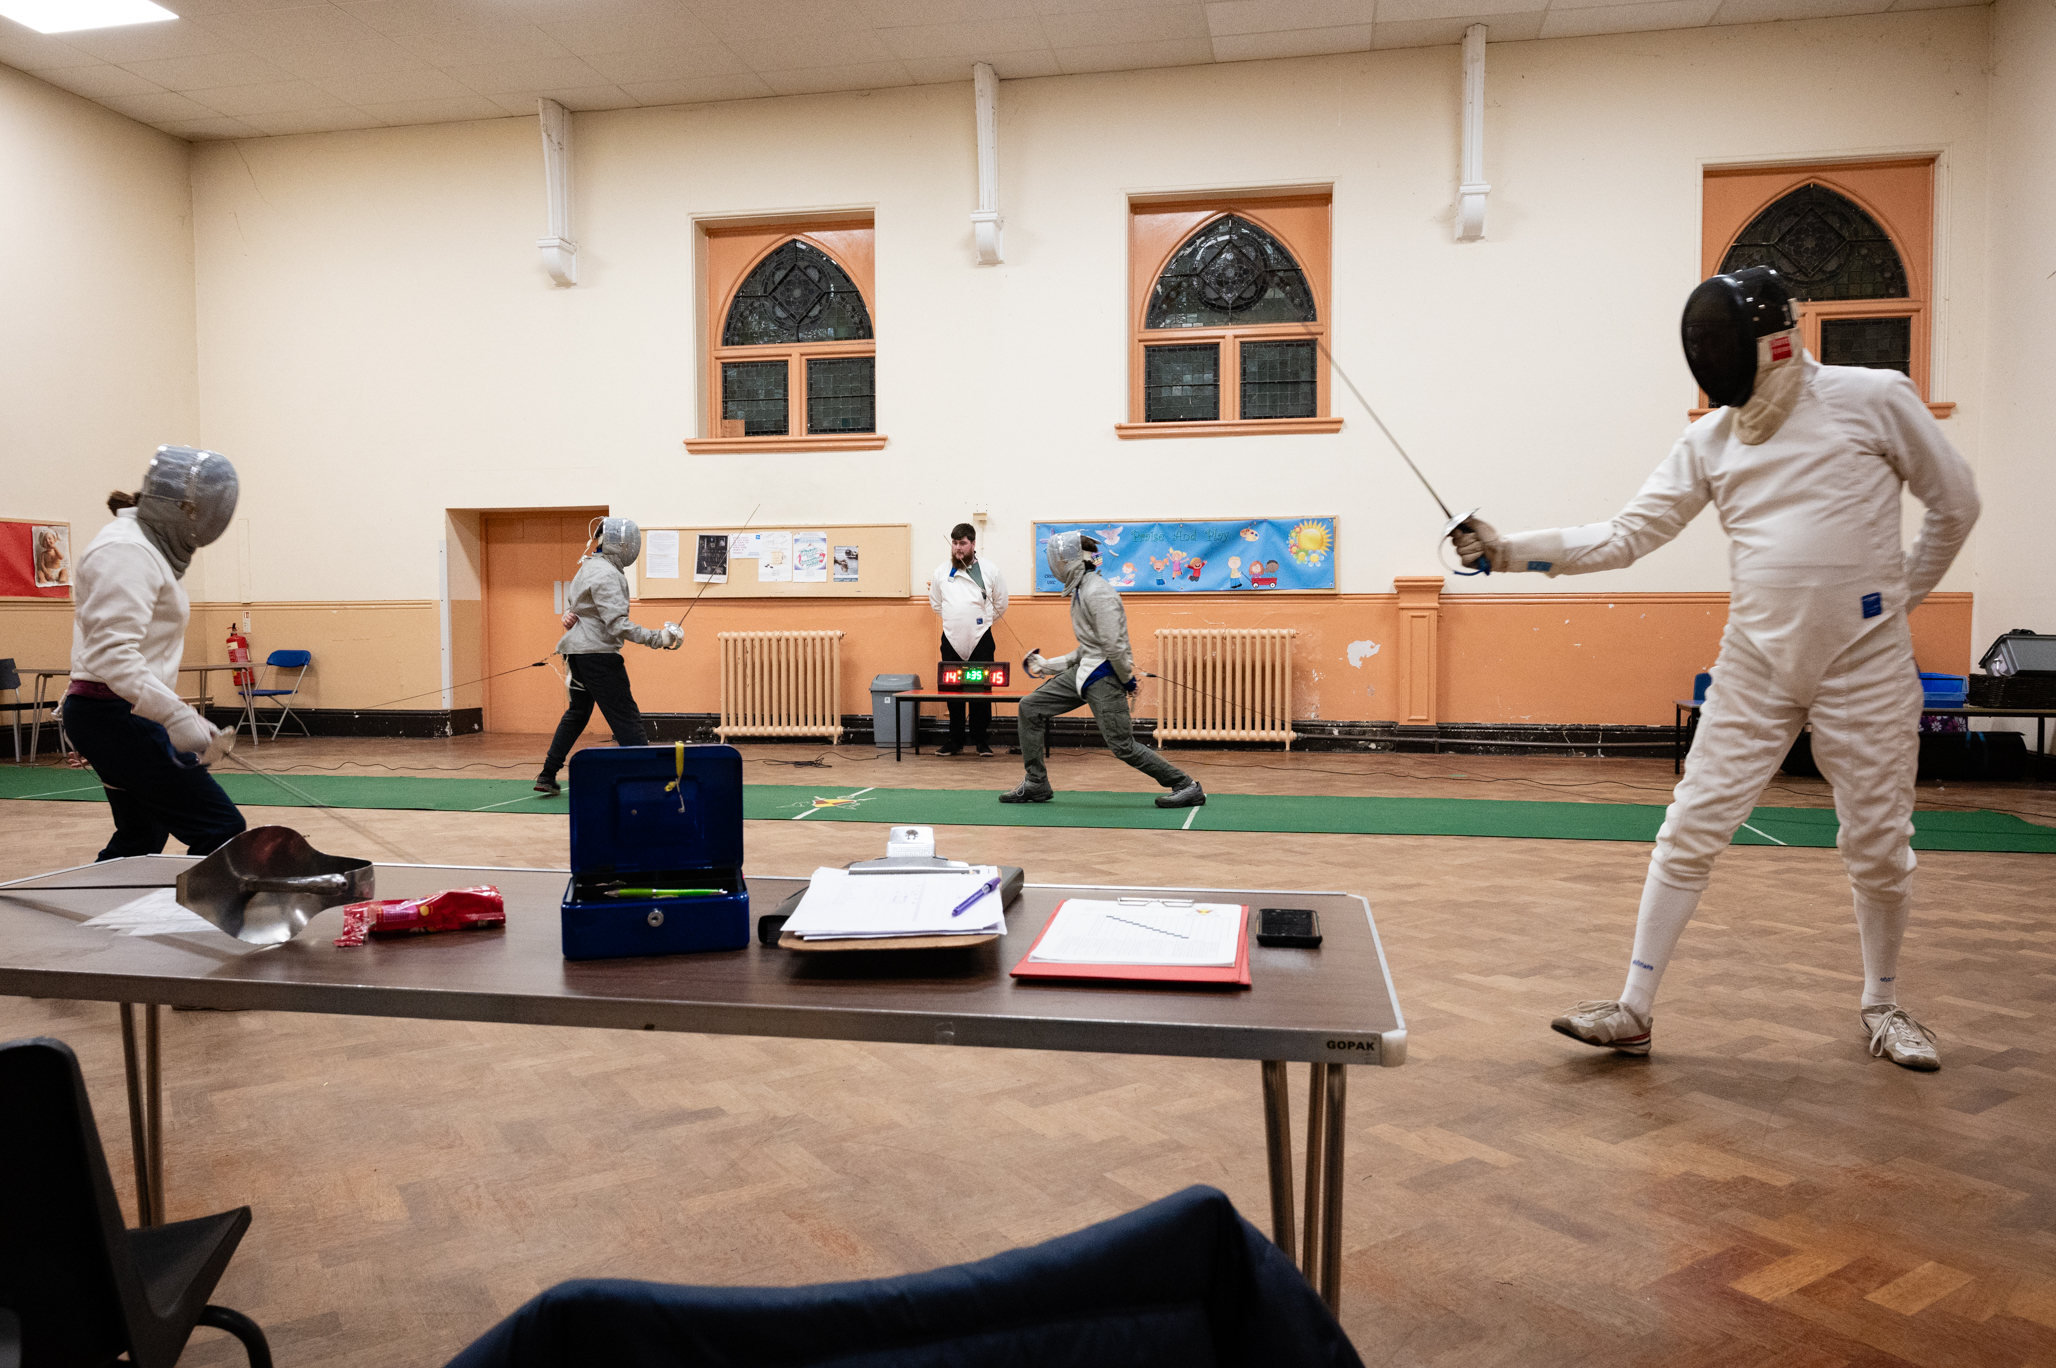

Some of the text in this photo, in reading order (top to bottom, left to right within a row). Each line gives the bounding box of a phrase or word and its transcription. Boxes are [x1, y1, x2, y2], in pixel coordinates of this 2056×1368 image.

[1131, 528, 1230, 543] Praise And Play
[944, 671, 957, 684] 14
[992, 671, 1004, 685] 15
[1326, 1040, 1375, 1051] GOPAK
